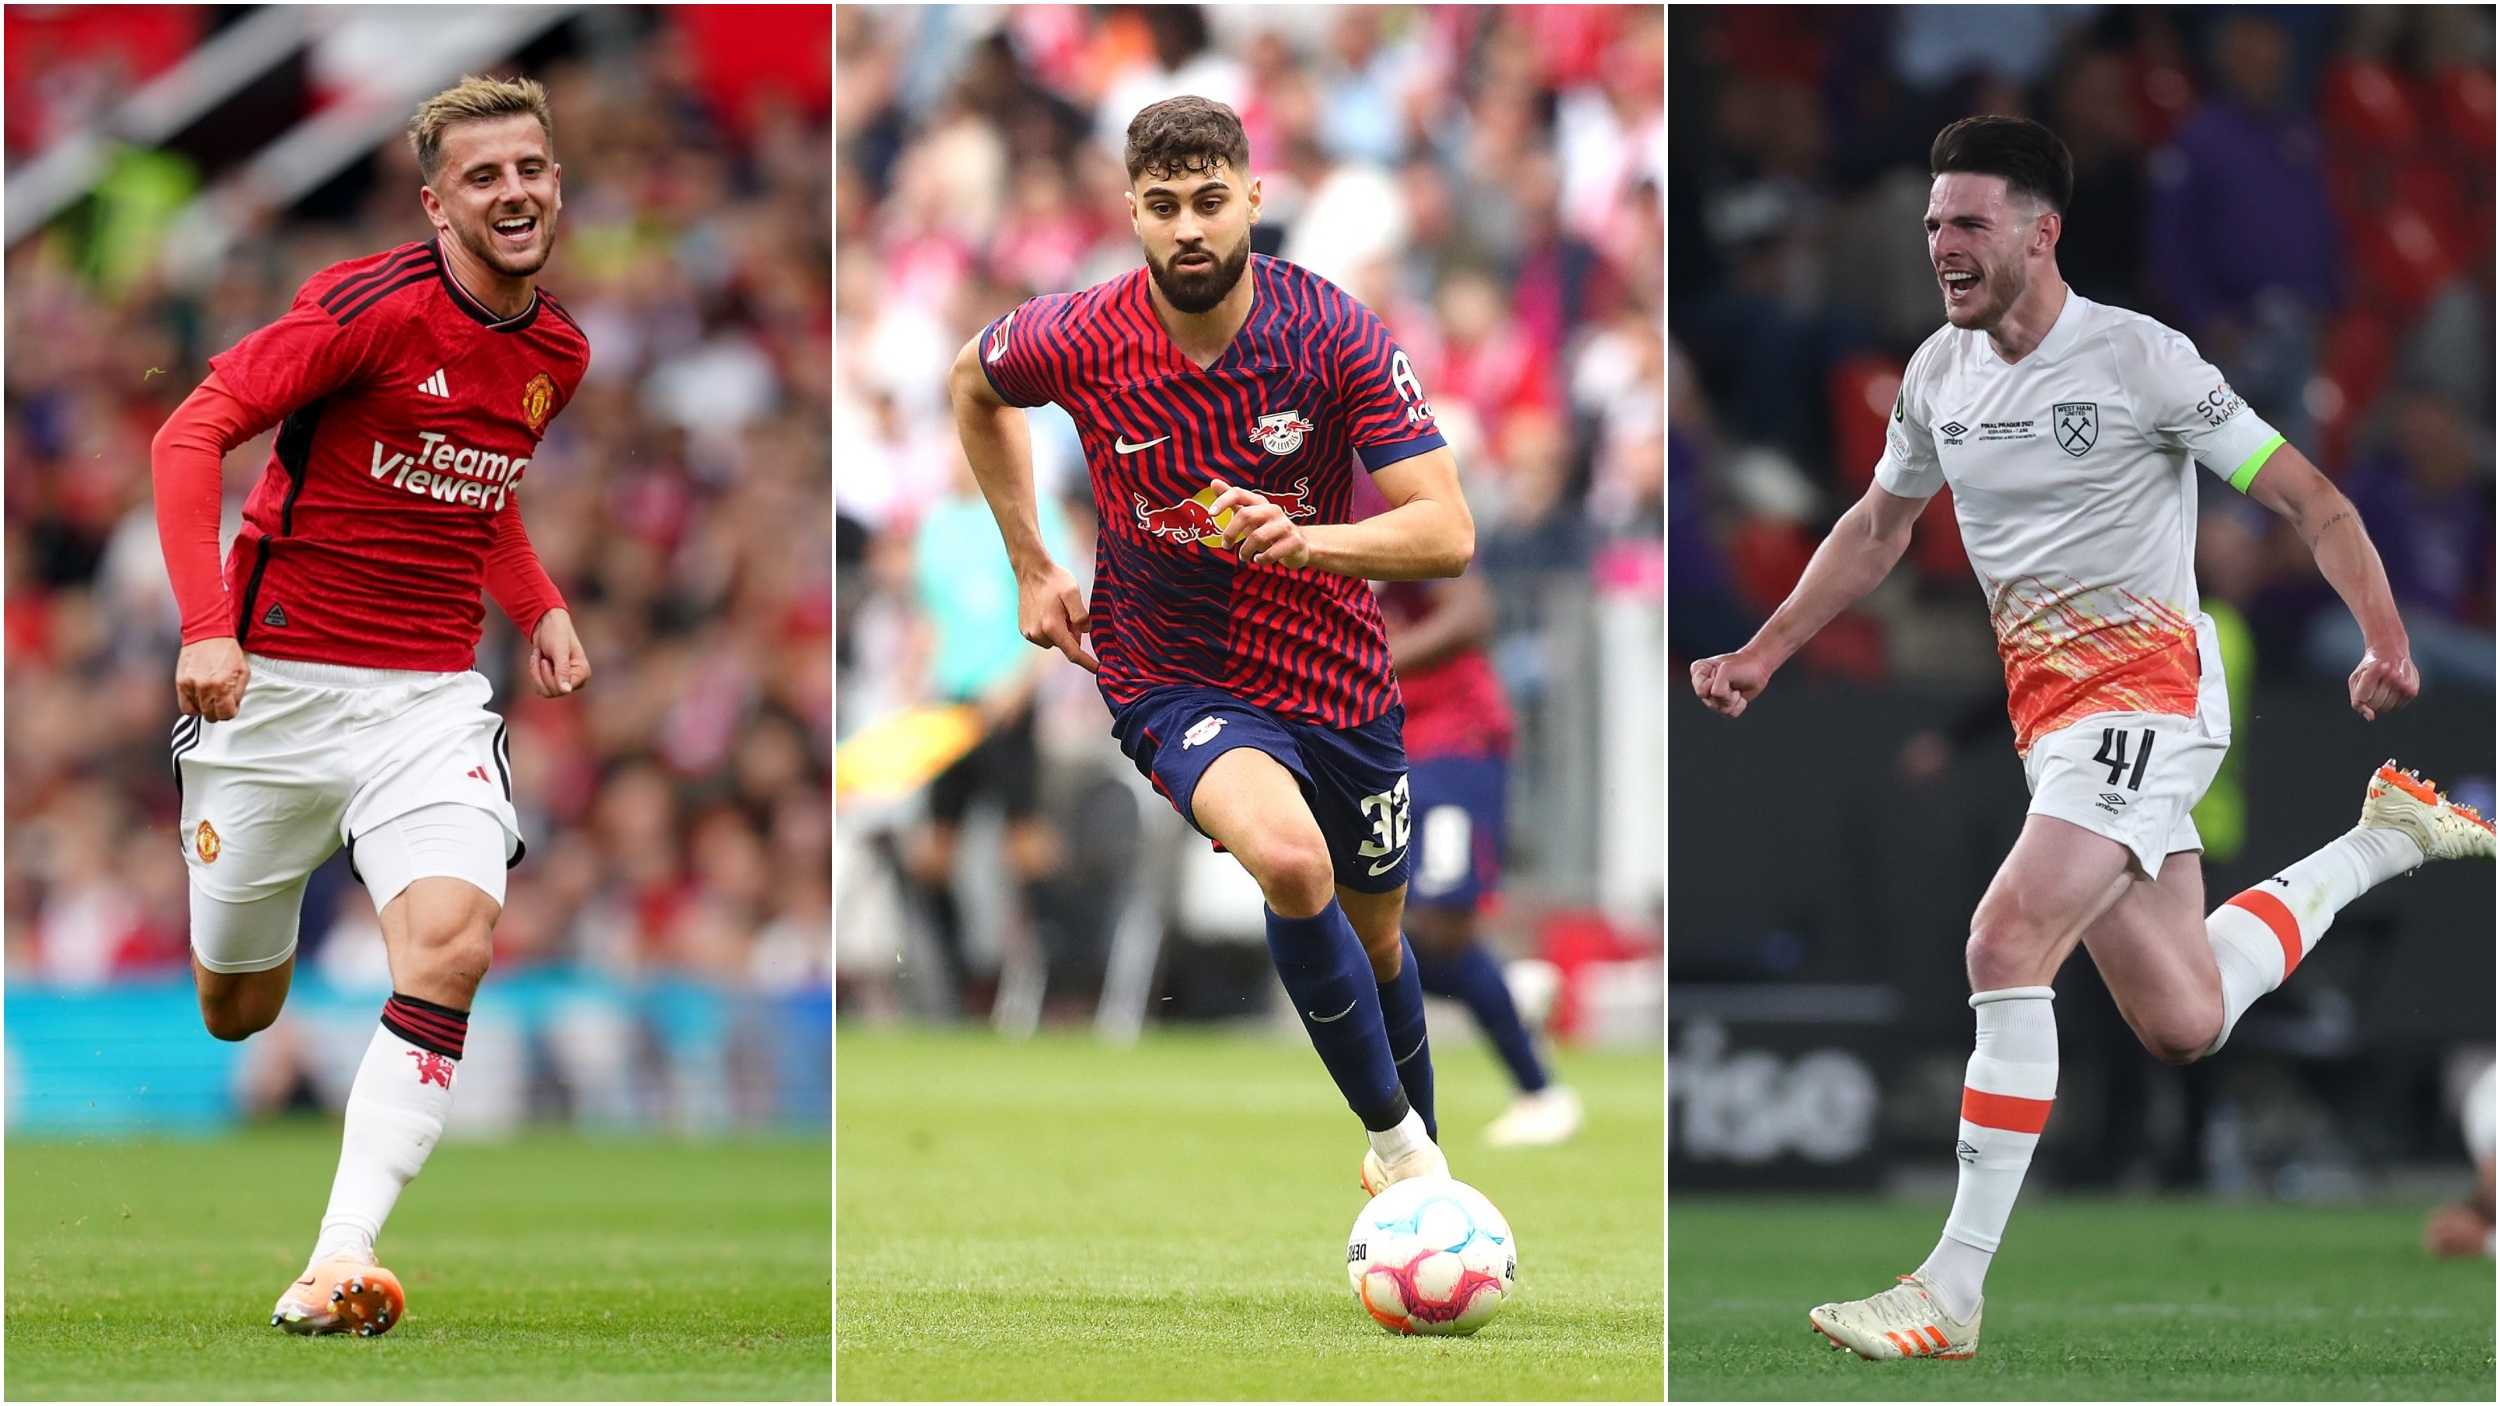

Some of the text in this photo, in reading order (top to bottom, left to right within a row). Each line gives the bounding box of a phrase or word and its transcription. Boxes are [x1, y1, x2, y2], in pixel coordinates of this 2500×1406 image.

[370, 440, 499, 510] Viewer
[418, 431, 509, 482] Team
[2092, 727, 2156, 792] 41
[1358, 772, 1411, 858] 32
[2095, 801, 2119, 815] umbro
